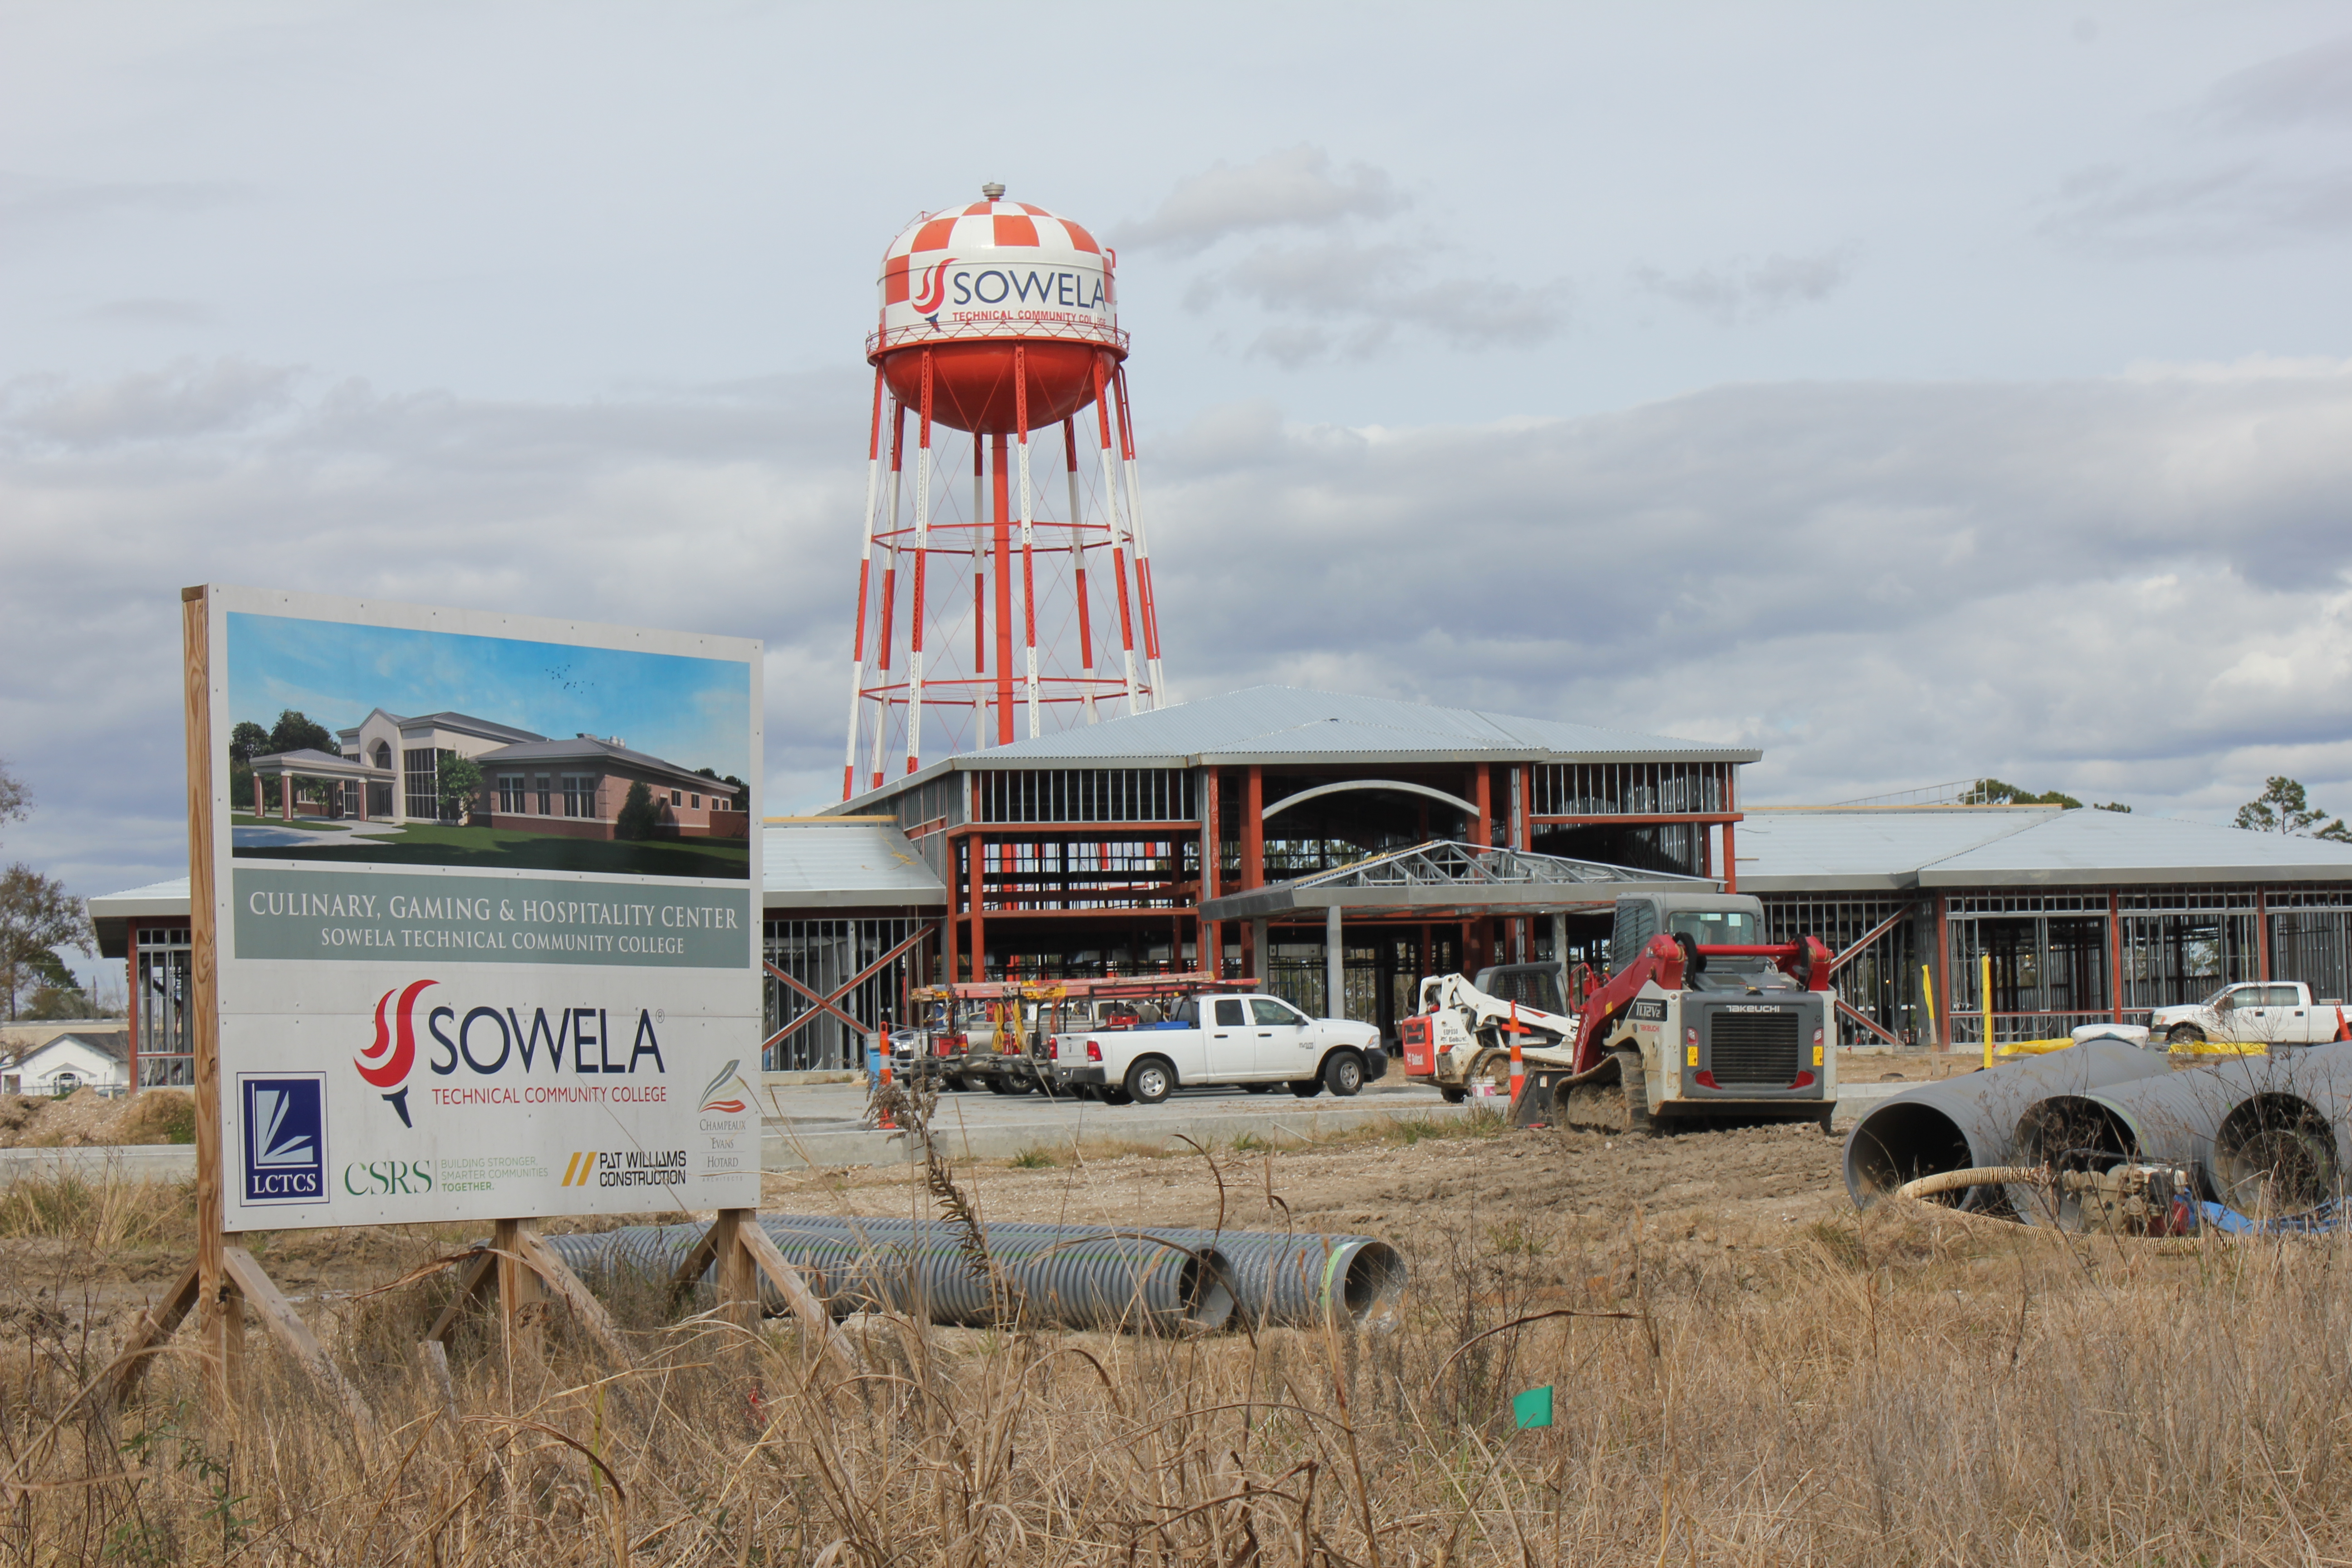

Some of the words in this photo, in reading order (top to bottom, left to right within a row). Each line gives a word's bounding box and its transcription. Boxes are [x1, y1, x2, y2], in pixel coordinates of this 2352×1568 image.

[953, 270, 1106, 312] SOWELA
[952, 310, 1014, 322] TECHNICAL
[1018, 310, 1077, 322] COMMUNITY
[1078, 314, 1106, 326] COLEGE
[250, 892, 380, 921] CULINARY,
[389, 896, 491, 921] GAMING
[500, 899, 516, 921] &
[523, 900, 656, 926] HOSPITALITY
[661, 906, 738, 929] CENTER
[322, 928, 396, 946] SOWELA
[401, 930, 506, 949] TECHNICAL
[512, 932, 614, 952] COMMUNITY
[618, 936, 684, 954] COLLEGE
[1573, 1013, 1589, 1076] AKEUCHI
[431, 1088, 520, 1105] TECHNICAL
[525, 1087, 608, 1103] COMMUNITY
[612, 1086, 666, 1102] COLLEGE
[441, 1158, 485, 1168] BUILDING
[487, 1156, 538, 1166] STRONGER,
[600, 1152, 622, 1169] PAT
[626, 1150, 686, 1168] WILLIAMS
[344, 1160, 432, 1196] CSRS
[441, 1170, 485, 1180] SMARTER
[488, 1167, 548, 1179] COMMUNITIES
[600, 1169, 686, 1187] CONSTRUCTION
[253, 1173, 316, 1194] LCTCS
[441, 1181, 495, 1192] TOGETHER.
